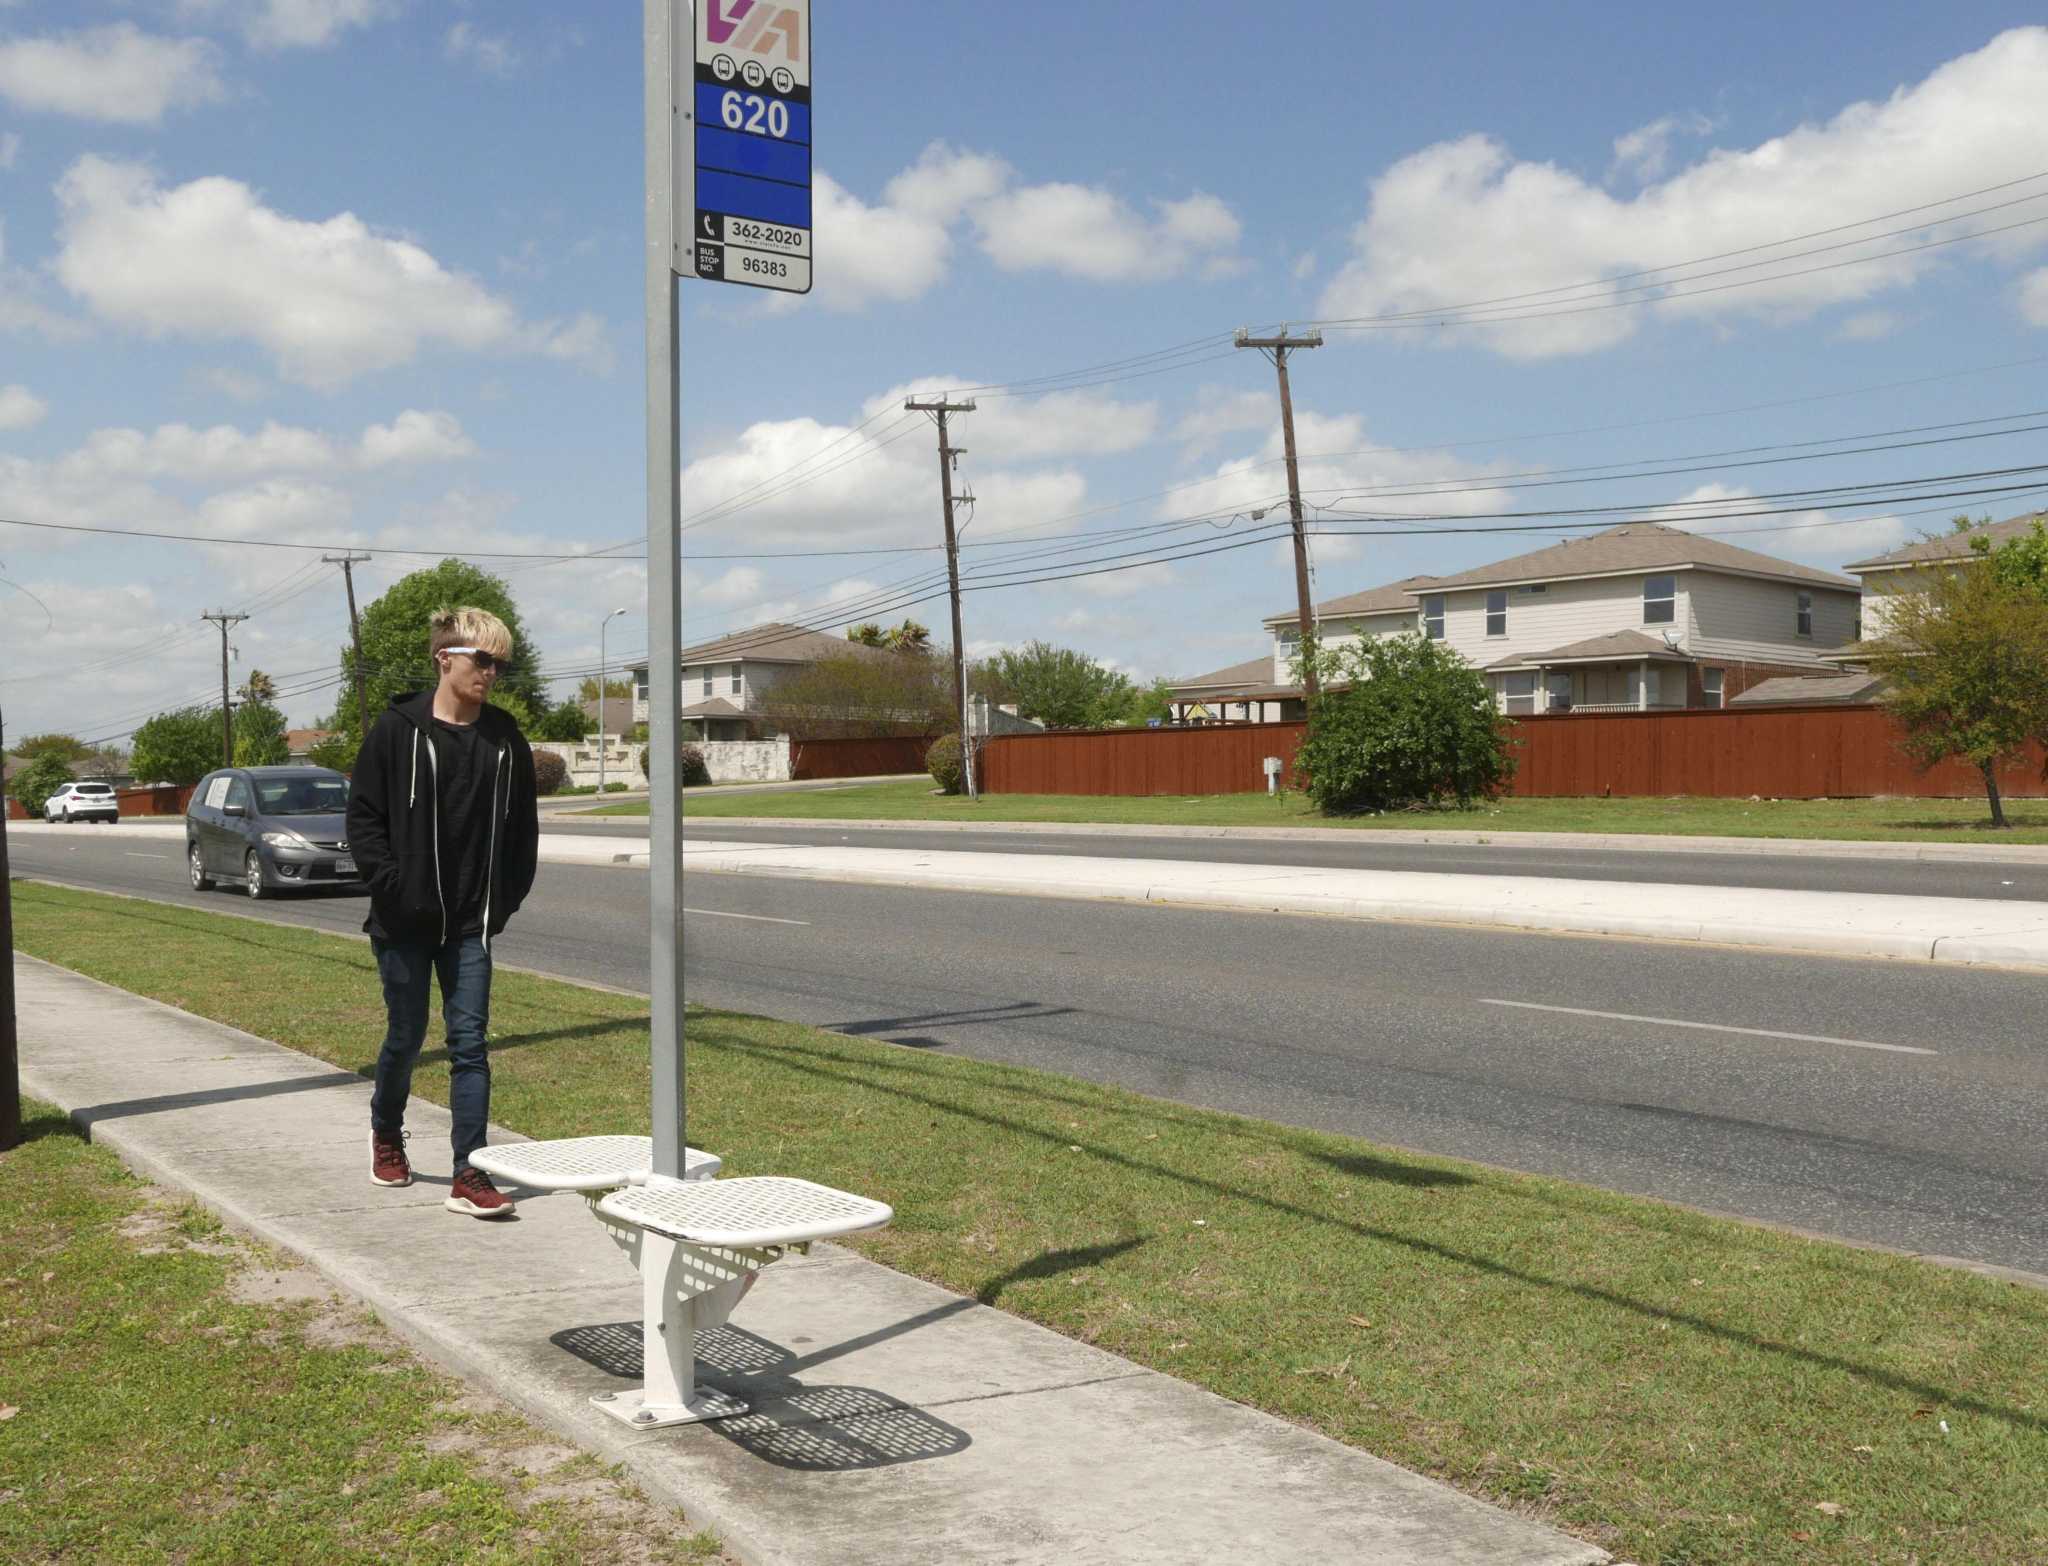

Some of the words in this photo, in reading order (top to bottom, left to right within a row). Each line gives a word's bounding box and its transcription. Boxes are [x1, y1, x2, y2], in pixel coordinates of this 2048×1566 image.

[707, 0, 800, 62] VIA
[722, 91, 788, 137] 620
[732, 222, 802, 246] 362-2020
[700, 247, 714, 256] BUS
[700, 256, 719, 264] STOP
[743, 257, 787, 277] 96383
